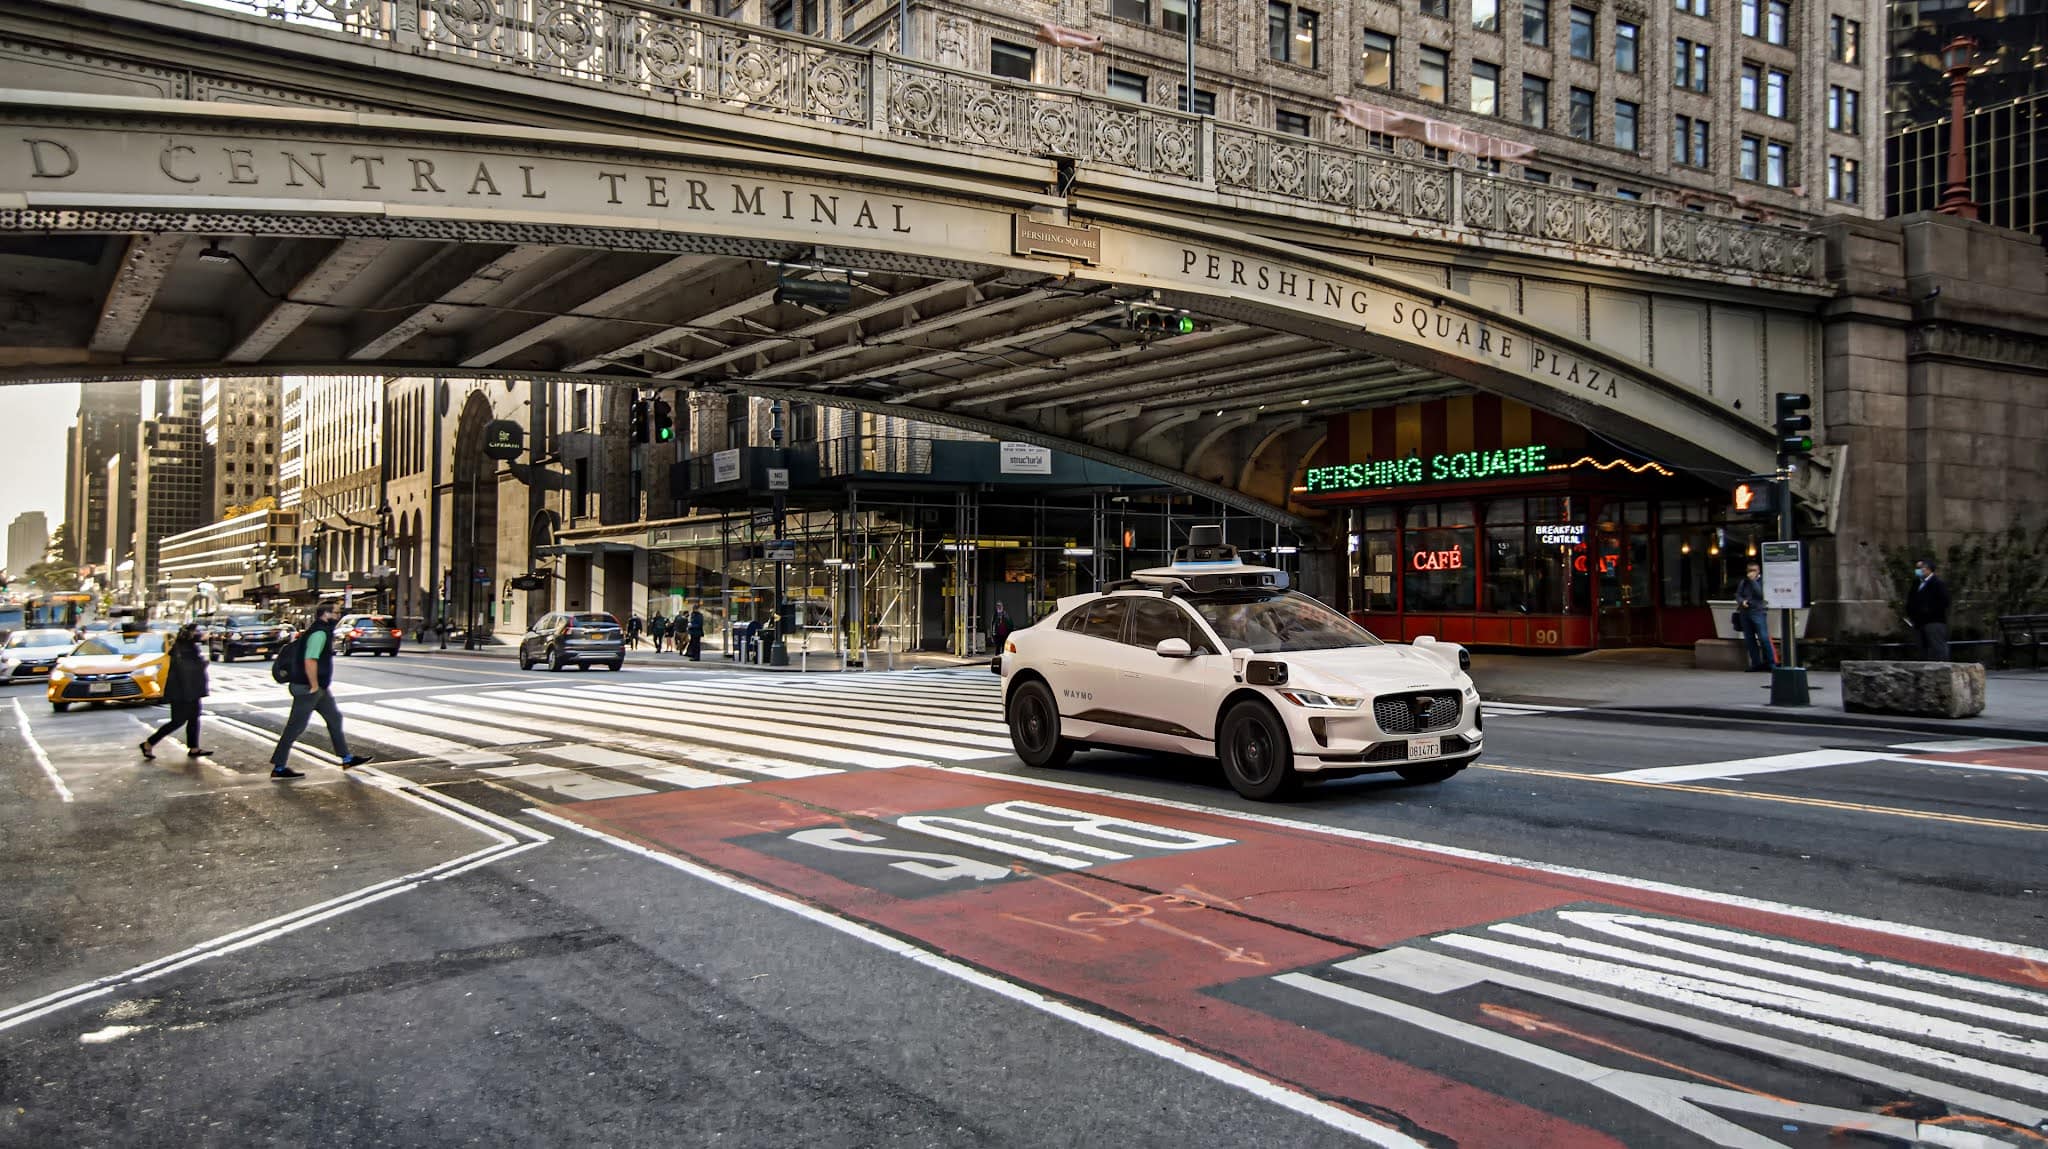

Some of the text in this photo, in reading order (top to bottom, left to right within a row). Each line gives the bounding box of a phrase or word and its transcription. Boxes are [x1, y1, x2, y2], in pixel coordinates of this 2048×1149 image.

[160, 143, 546, 199] CENTRAL
[598, 171, 911, 233] TERMINAL
[1022, 229, 1097, 249] PERSHING SQUARE
[1181, 249, 1618, 399] PERSHING SQUARE PLAZA
[1307, 445, 1547, 491] PERSHING SQUARE
[1536, 525, 1585, 535] BREAKFAST
[1541, 534, 1581, 544] CENTRAL
[1413, 544, 1462, 570] CAFÉ
[1536, 629, 1558, 644] 90
[1063, 688, 1093, 701] WAYMO
[787, 800, 1238, 881] BUS
